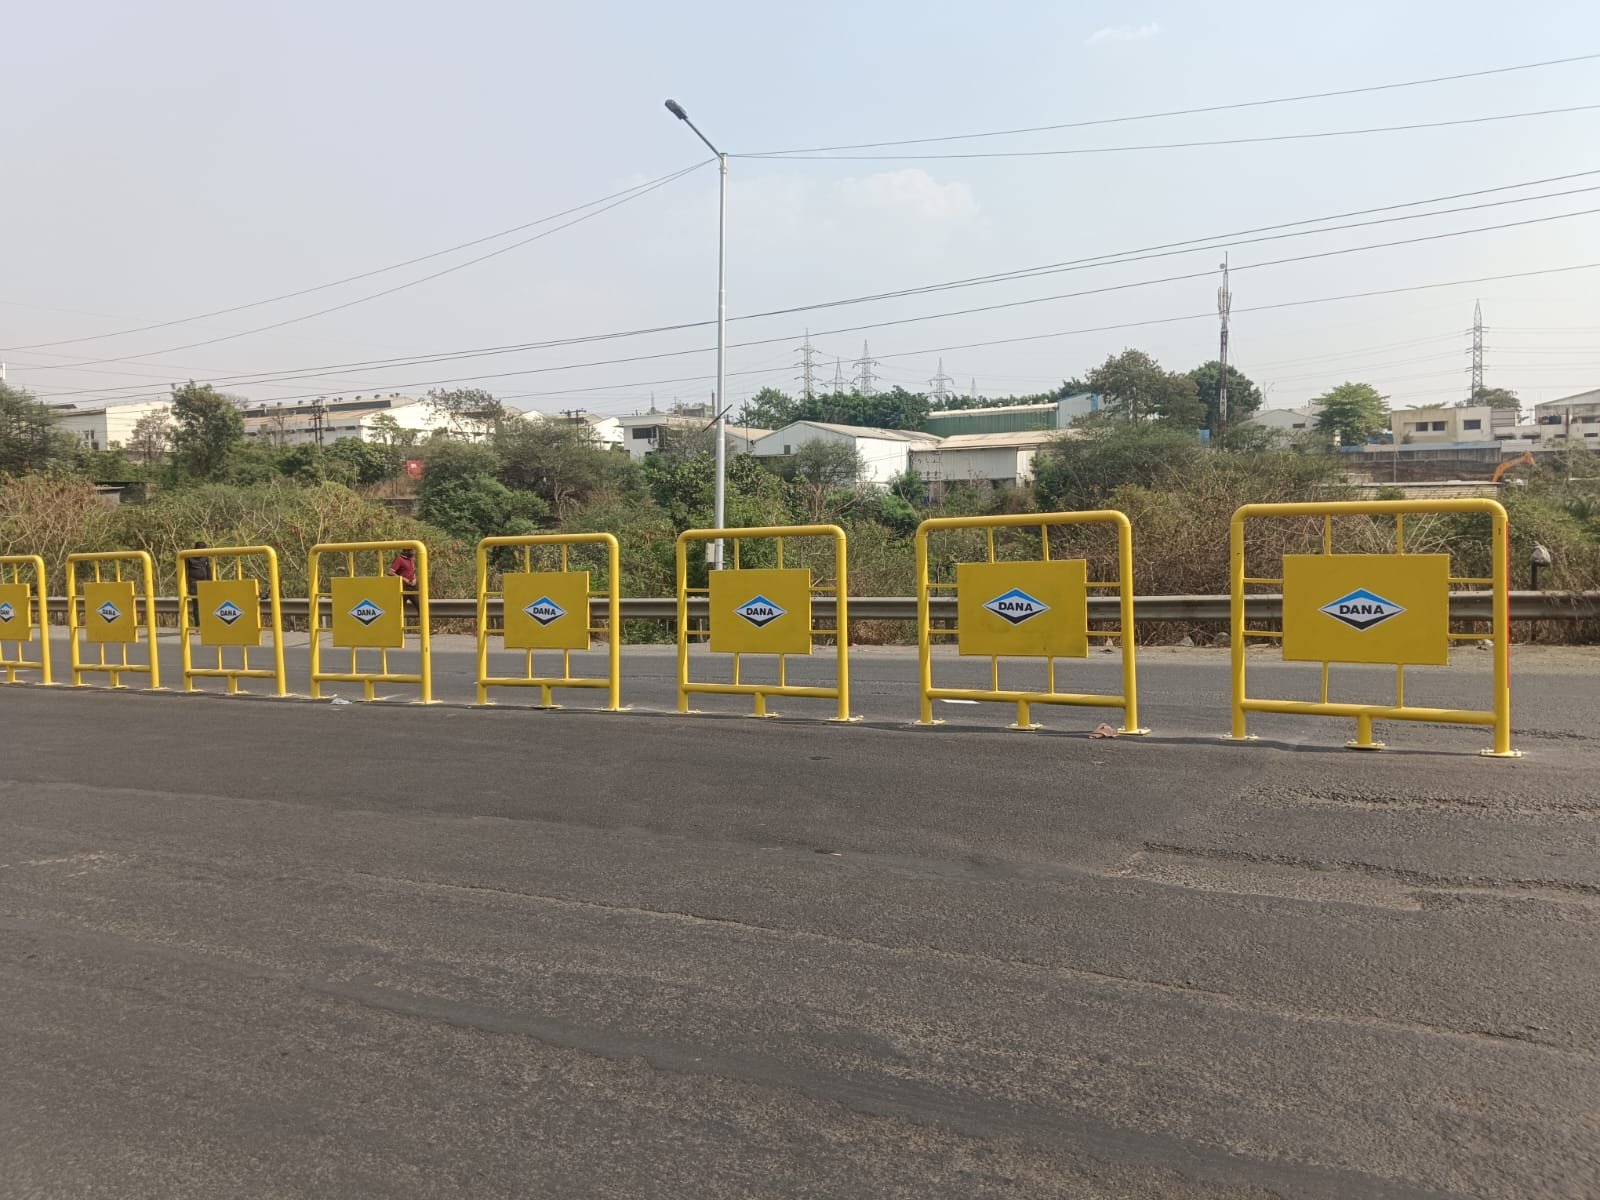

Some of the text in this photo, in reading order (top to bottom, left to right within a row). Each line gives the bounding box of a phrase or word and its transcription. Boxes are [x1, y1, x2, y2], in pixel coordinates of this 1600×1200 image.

[533, 607, 556, 616] DANA
[746, 607, 773, 616] DANA
[998, 602, 1033, 612] DANA
[1339, 604, 1385, 615] DANA
